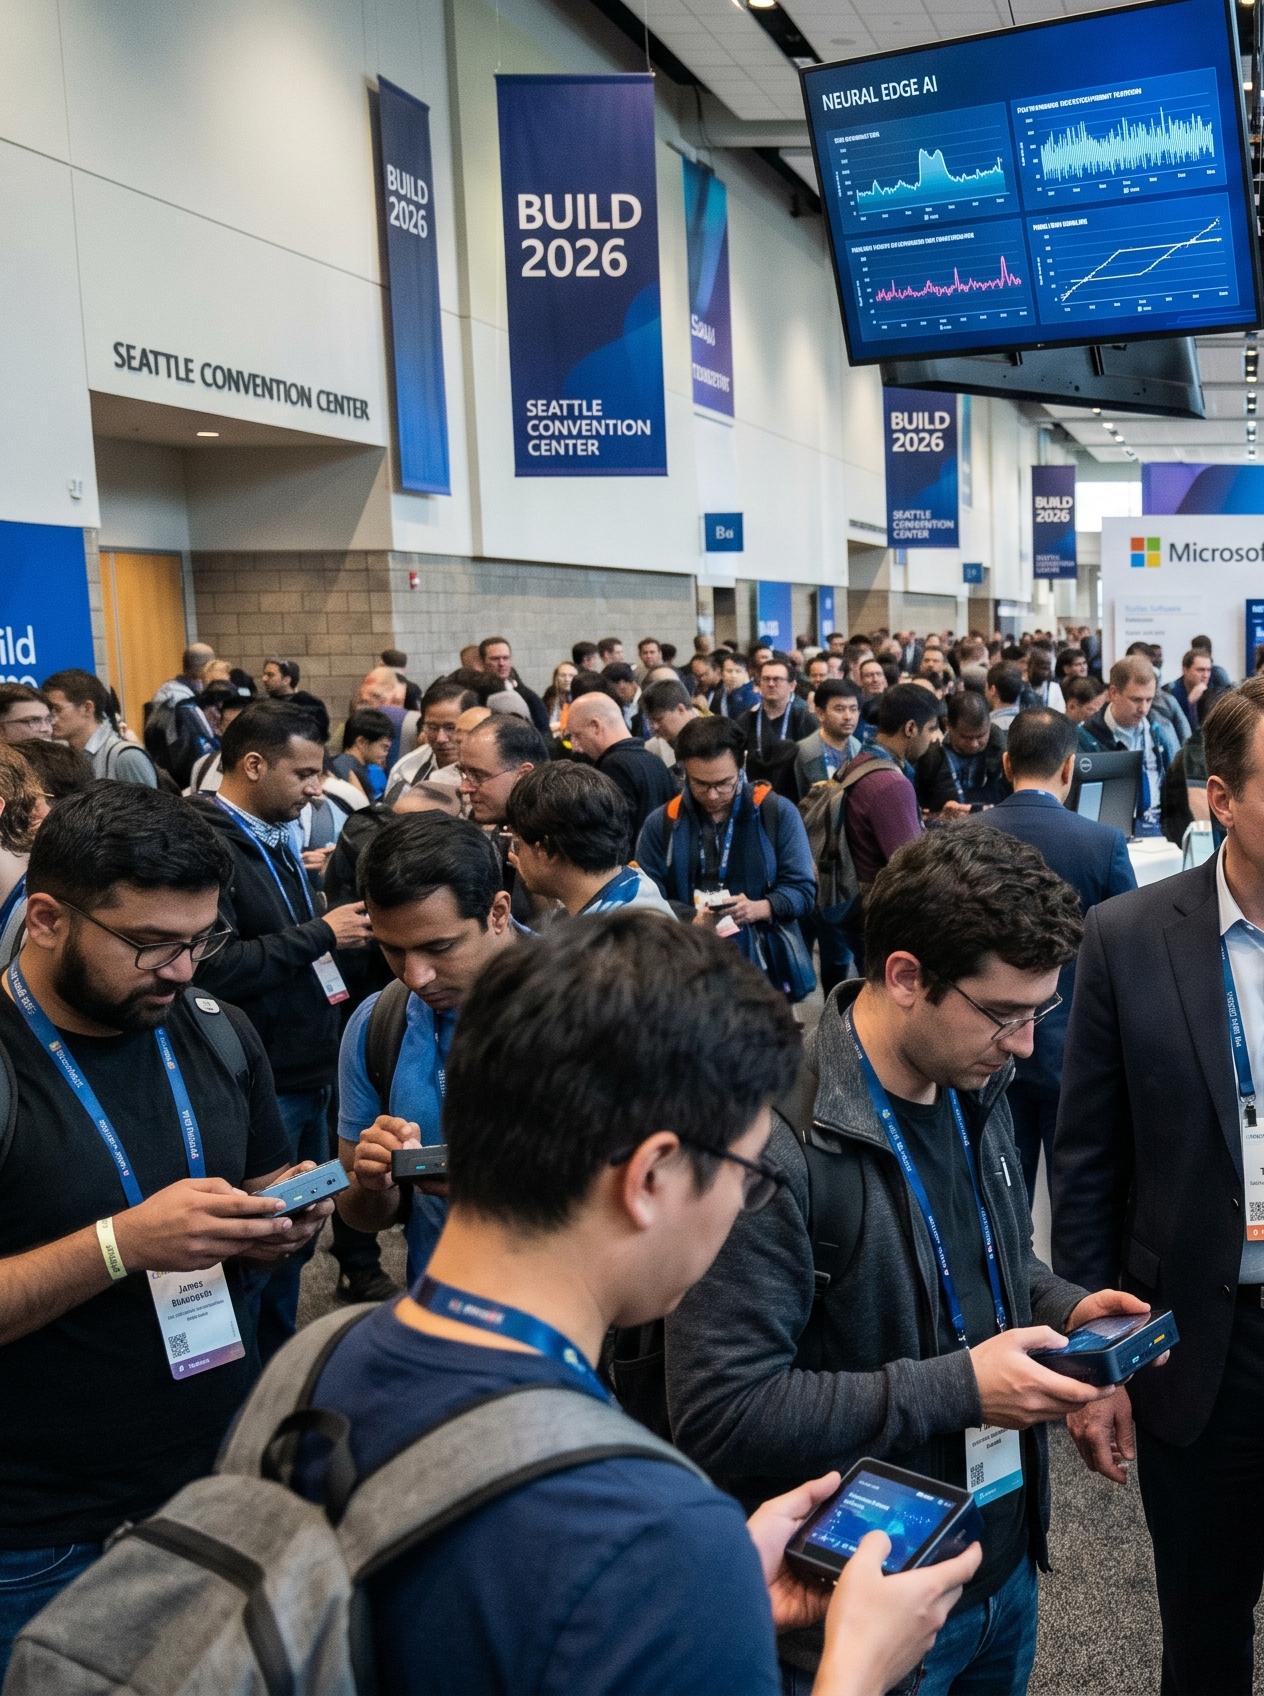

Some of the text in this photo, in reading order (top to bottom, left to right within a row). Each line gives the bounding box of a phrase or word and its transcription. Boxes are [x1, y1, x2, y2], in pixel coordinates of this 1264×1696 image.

[822, 75, 938, 111] NEURAL EDGE AI
[387, 164, 428, 205] BUILD
[389, 196, 428, 239] 2026
[517, 193, 642, 230] BUILD
[521, 238, 628, 278] 2026
[113, 341, 370, 421] SEATTLE CONVENTION CENTER
[526, 399, 602, 416] SEATTLE
[527, 419, 651, 436] CONVENTION
[890, 411, 950, 430] BUILD
[527, 439, 599, 456] CENTER
[892, 432, 944, 452] 2026
[1035, 509, 1070, 523] 2026
[893, 529, 930, 539] CENTER
